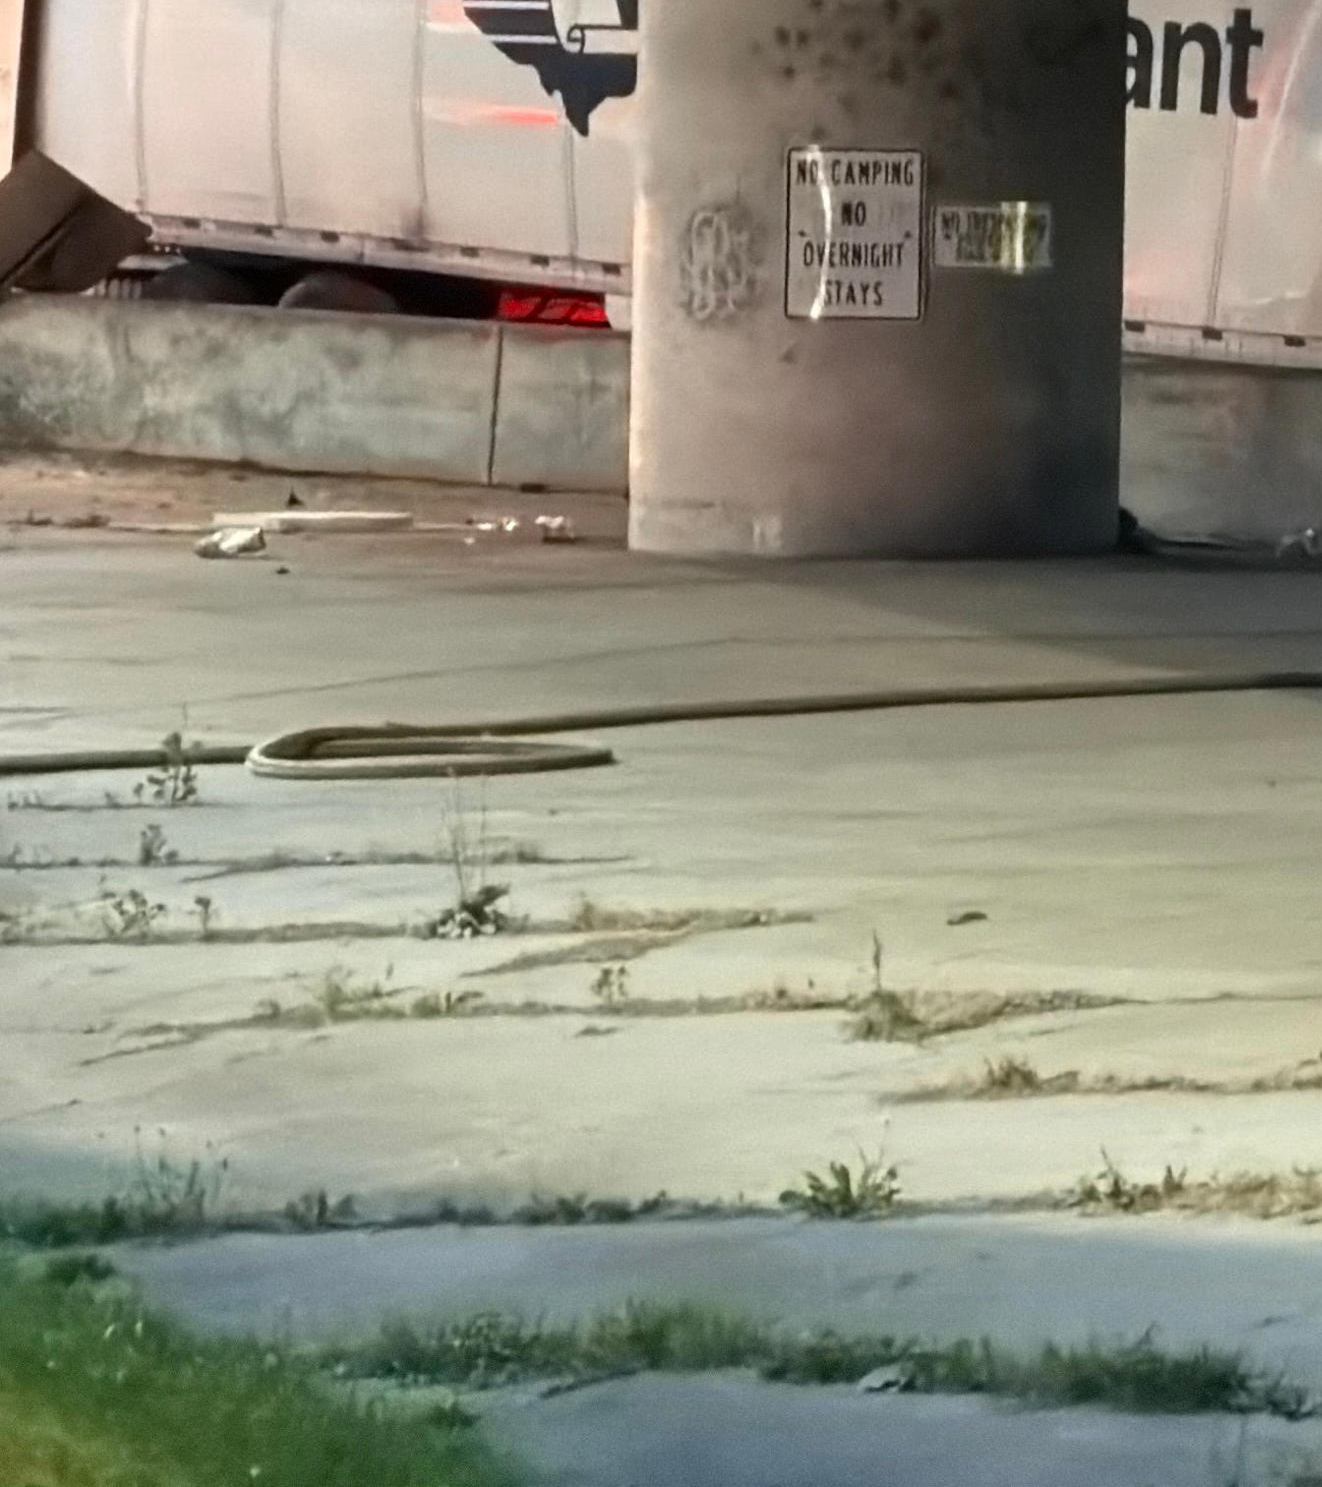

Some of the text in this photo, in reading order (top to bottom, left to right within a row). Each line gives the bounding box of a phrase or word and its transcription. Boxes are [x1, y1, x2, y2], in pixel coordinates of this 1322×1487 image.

[796, 159, 914, 186] NO CAMPING
[841, 200, 867, 227] NO
[803, 241, 904, 268] OVERNIGHT
[824, 279, 883, 306] STAYS
